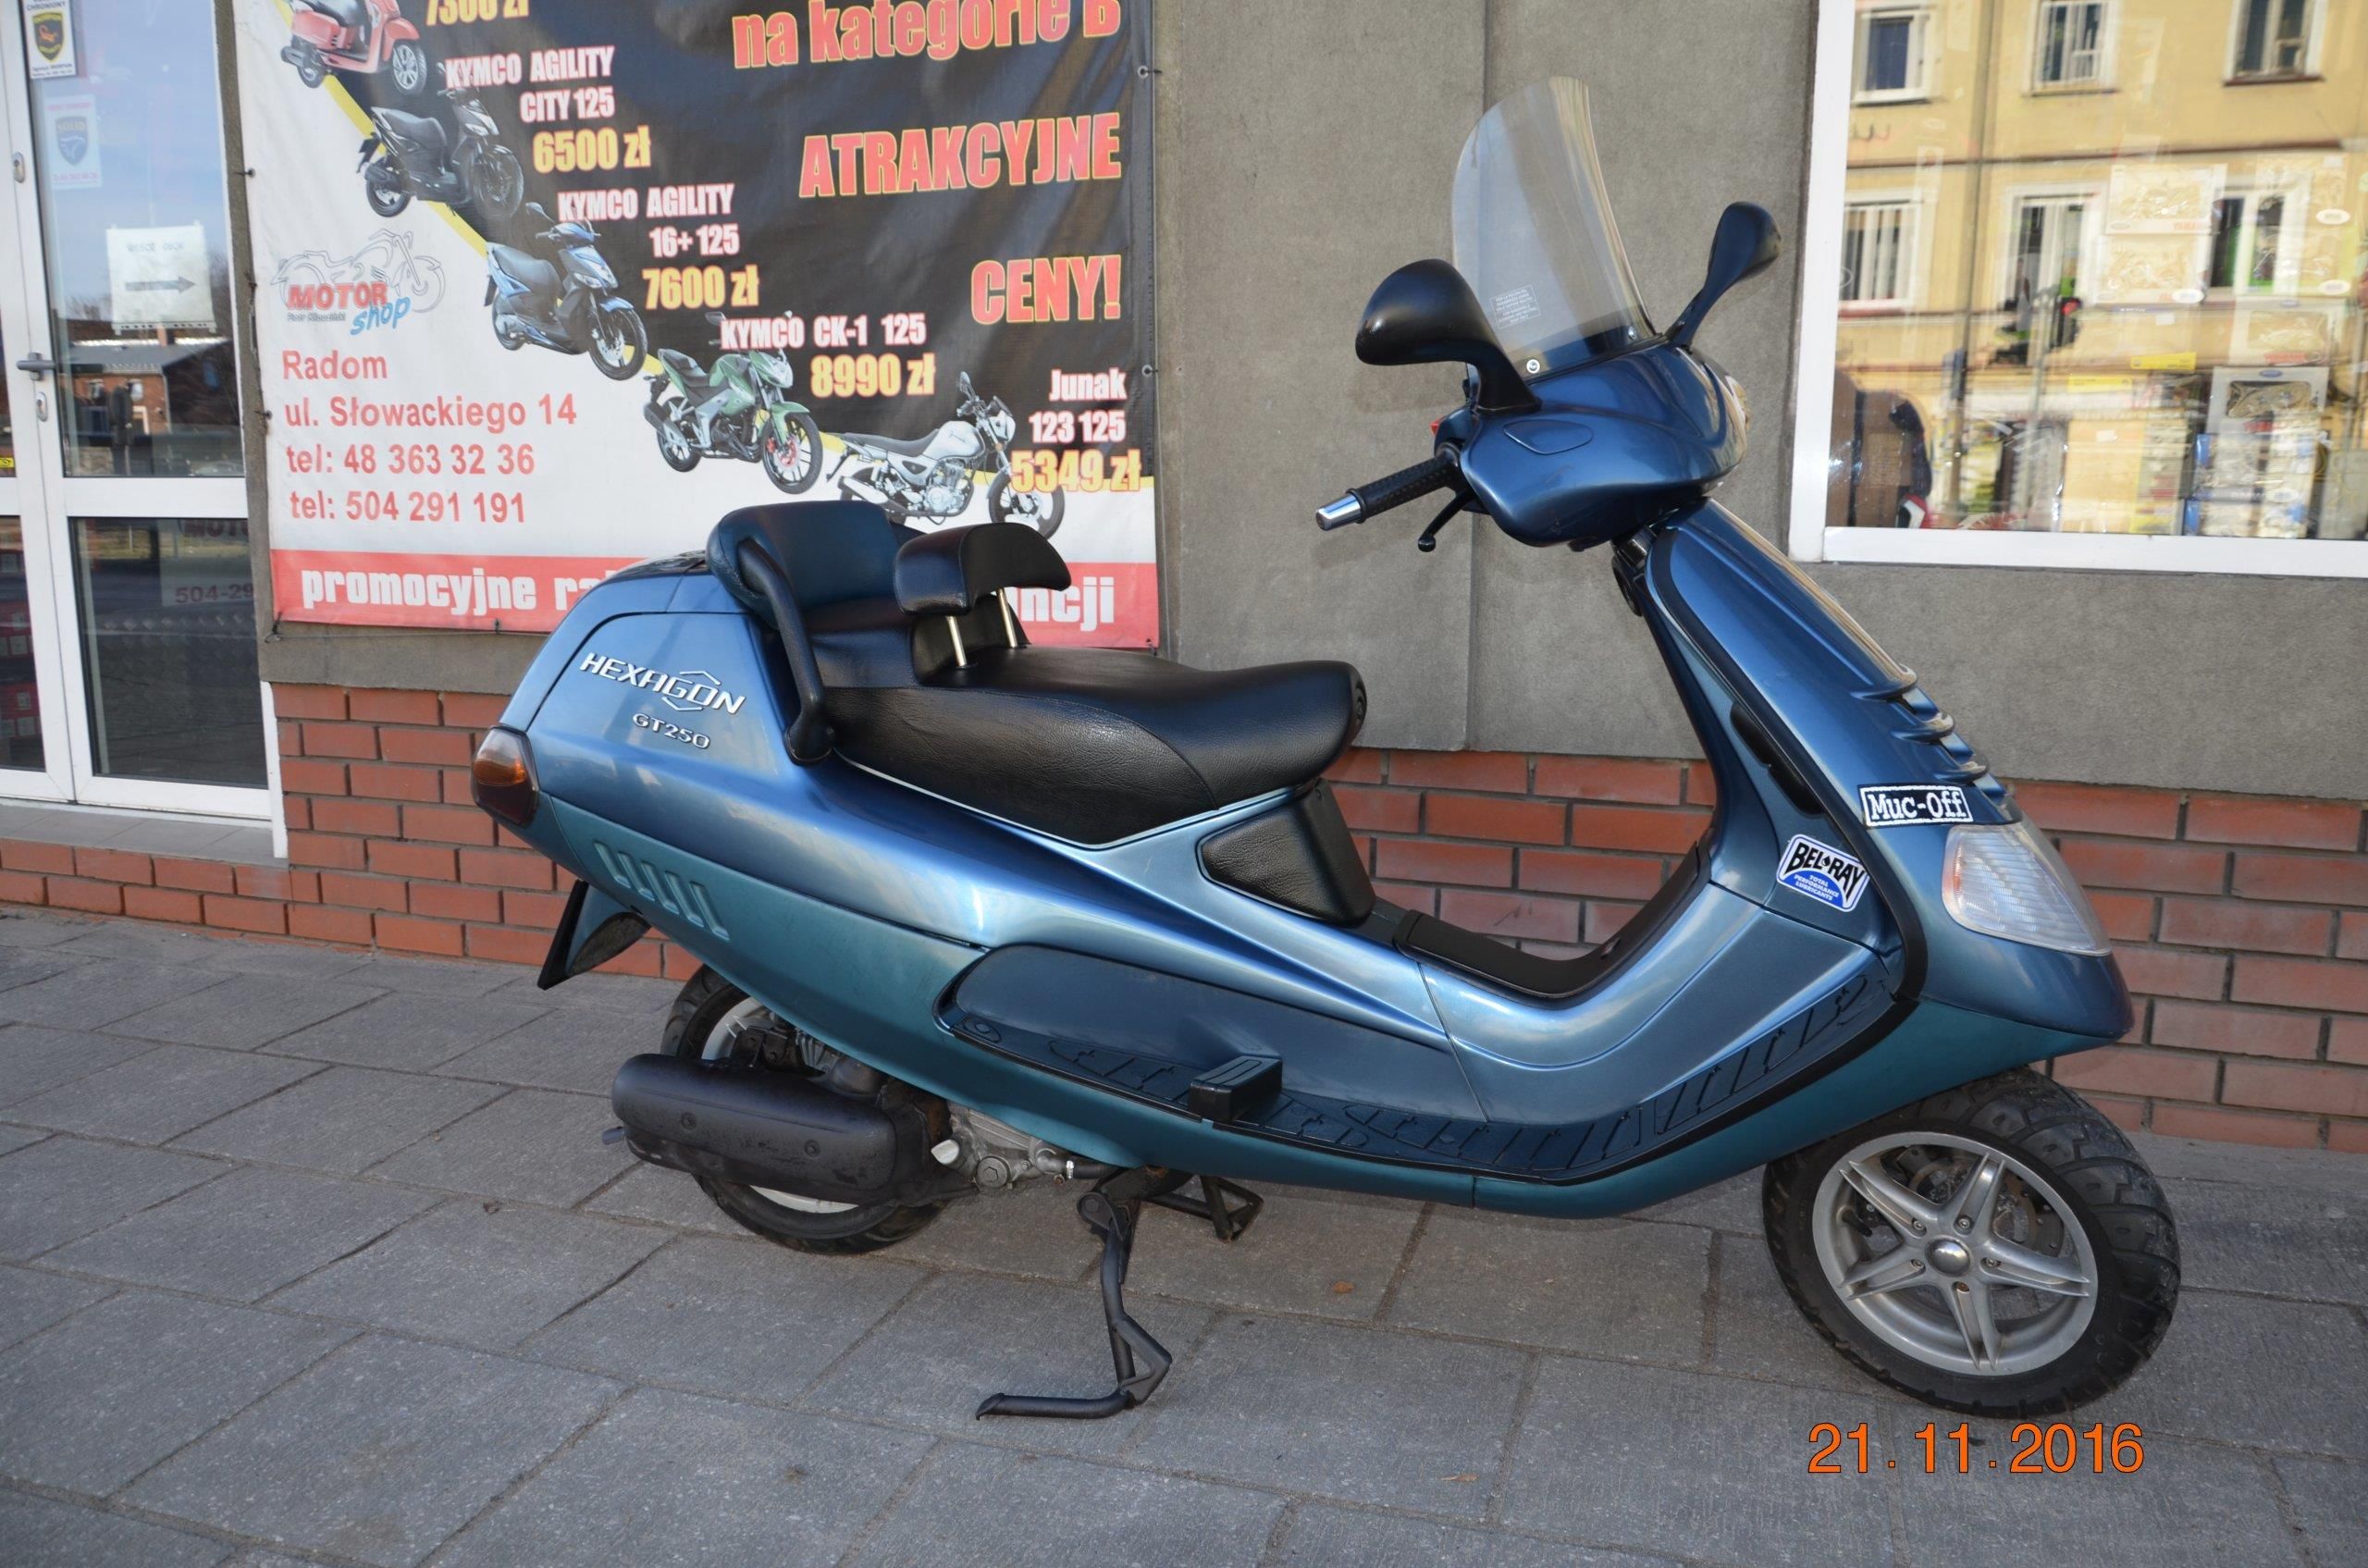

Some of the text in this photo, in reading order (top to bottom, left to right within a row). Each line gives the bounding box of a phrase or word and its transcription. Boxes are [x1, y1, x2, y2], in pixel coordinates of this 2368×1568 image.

[732, 0, 1121, 69] na kategorie B
[445, 46, 614, 89] KYMCO AGILITY
[520, 87, 614, 122] CITY 125
[533, 125, 651, 173] 6500 zł
[799, 112, 1121, 198] ATRAKCYJNE
[558, 183, 734, 222] KYMCO AGILITY
[649, 225, 739, 258] 16+ 125
[287, 280, 388, 310] MOTOR
[643, 265, 759, 310] 7600 zł
[970, 254, 1121, 325] CENY!
[350, 296, 412, 336] shop
[721, 313, 926, 350] KYMCO CK-1 125
[283, 349, 388, 380] Radom
[810, 352, 936, 398] 8990 zł
[1049, 366, 1128, 401] Junak
[285, 393, 576, 435] ul. Słowackiego 14
[1029, 409, 1126, 443] 123 125
[286, 443, 535, 475] tel: 48 363 32 36
[1010, 449, 1142, 493] 5349 zł
[290, 490, 525, 524] tel: 504 291 191
[301, 567, 537, 616] promocyjne
[579, 651, 746, 714] HEXAGON
[632, 711, 711, 750] GT250
[1867, 791, 1967, 821] Muc-Off
[1793, 873, 1840, 899] PERFORMANCE
[1808, 873, 1829, 887] TOTAL
